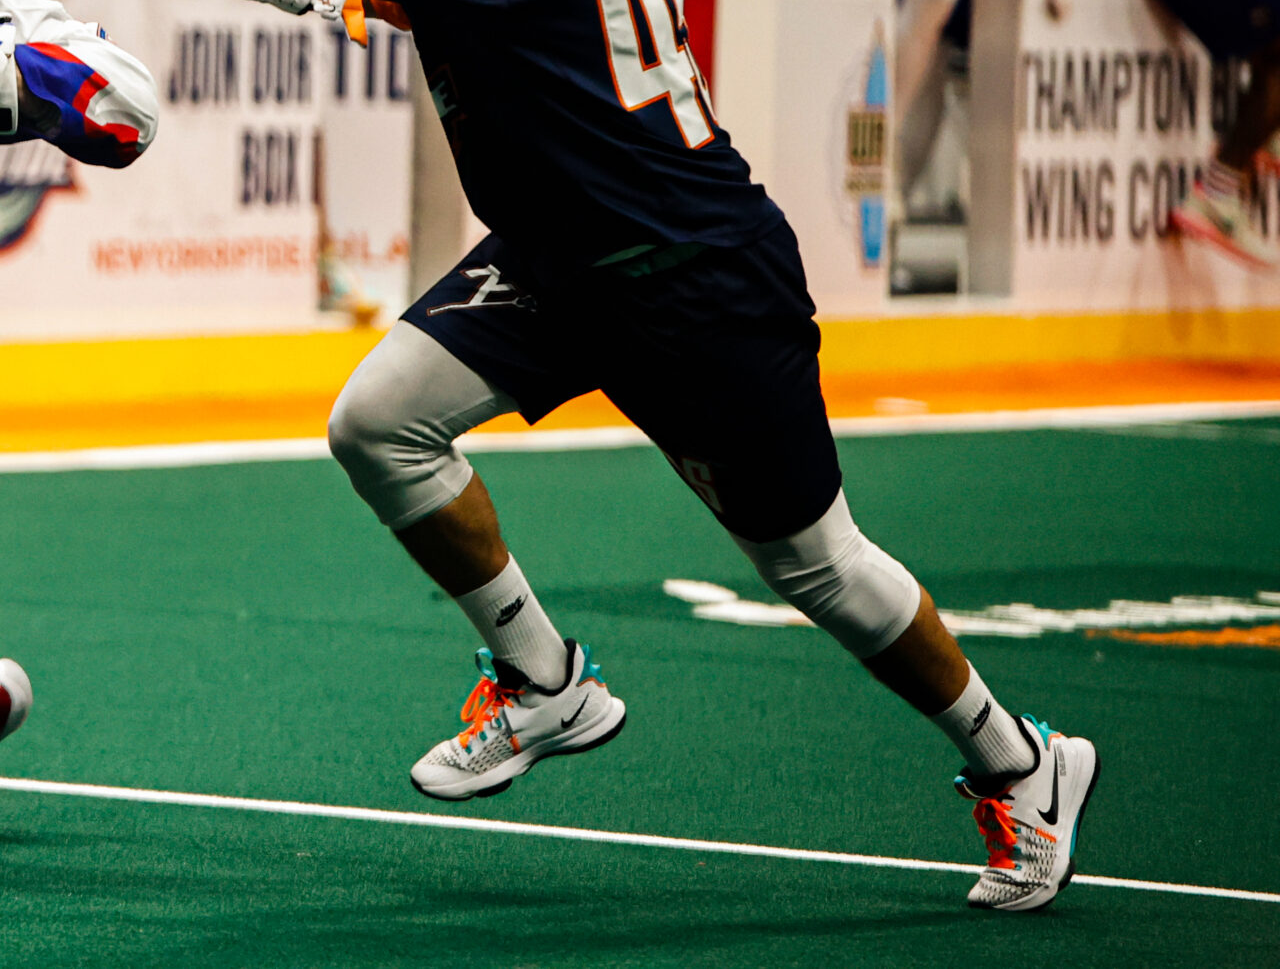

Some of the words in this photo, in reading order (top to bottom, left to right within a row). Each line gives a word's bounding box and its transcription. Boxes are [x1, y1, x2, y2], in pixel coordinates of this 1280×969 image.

[166, 24, 239, 104] JOIN
[254, 24, 312, 104] OUR
[237, 126, 300, 205] BOX
[1022, 162, 1116, 241] WING
